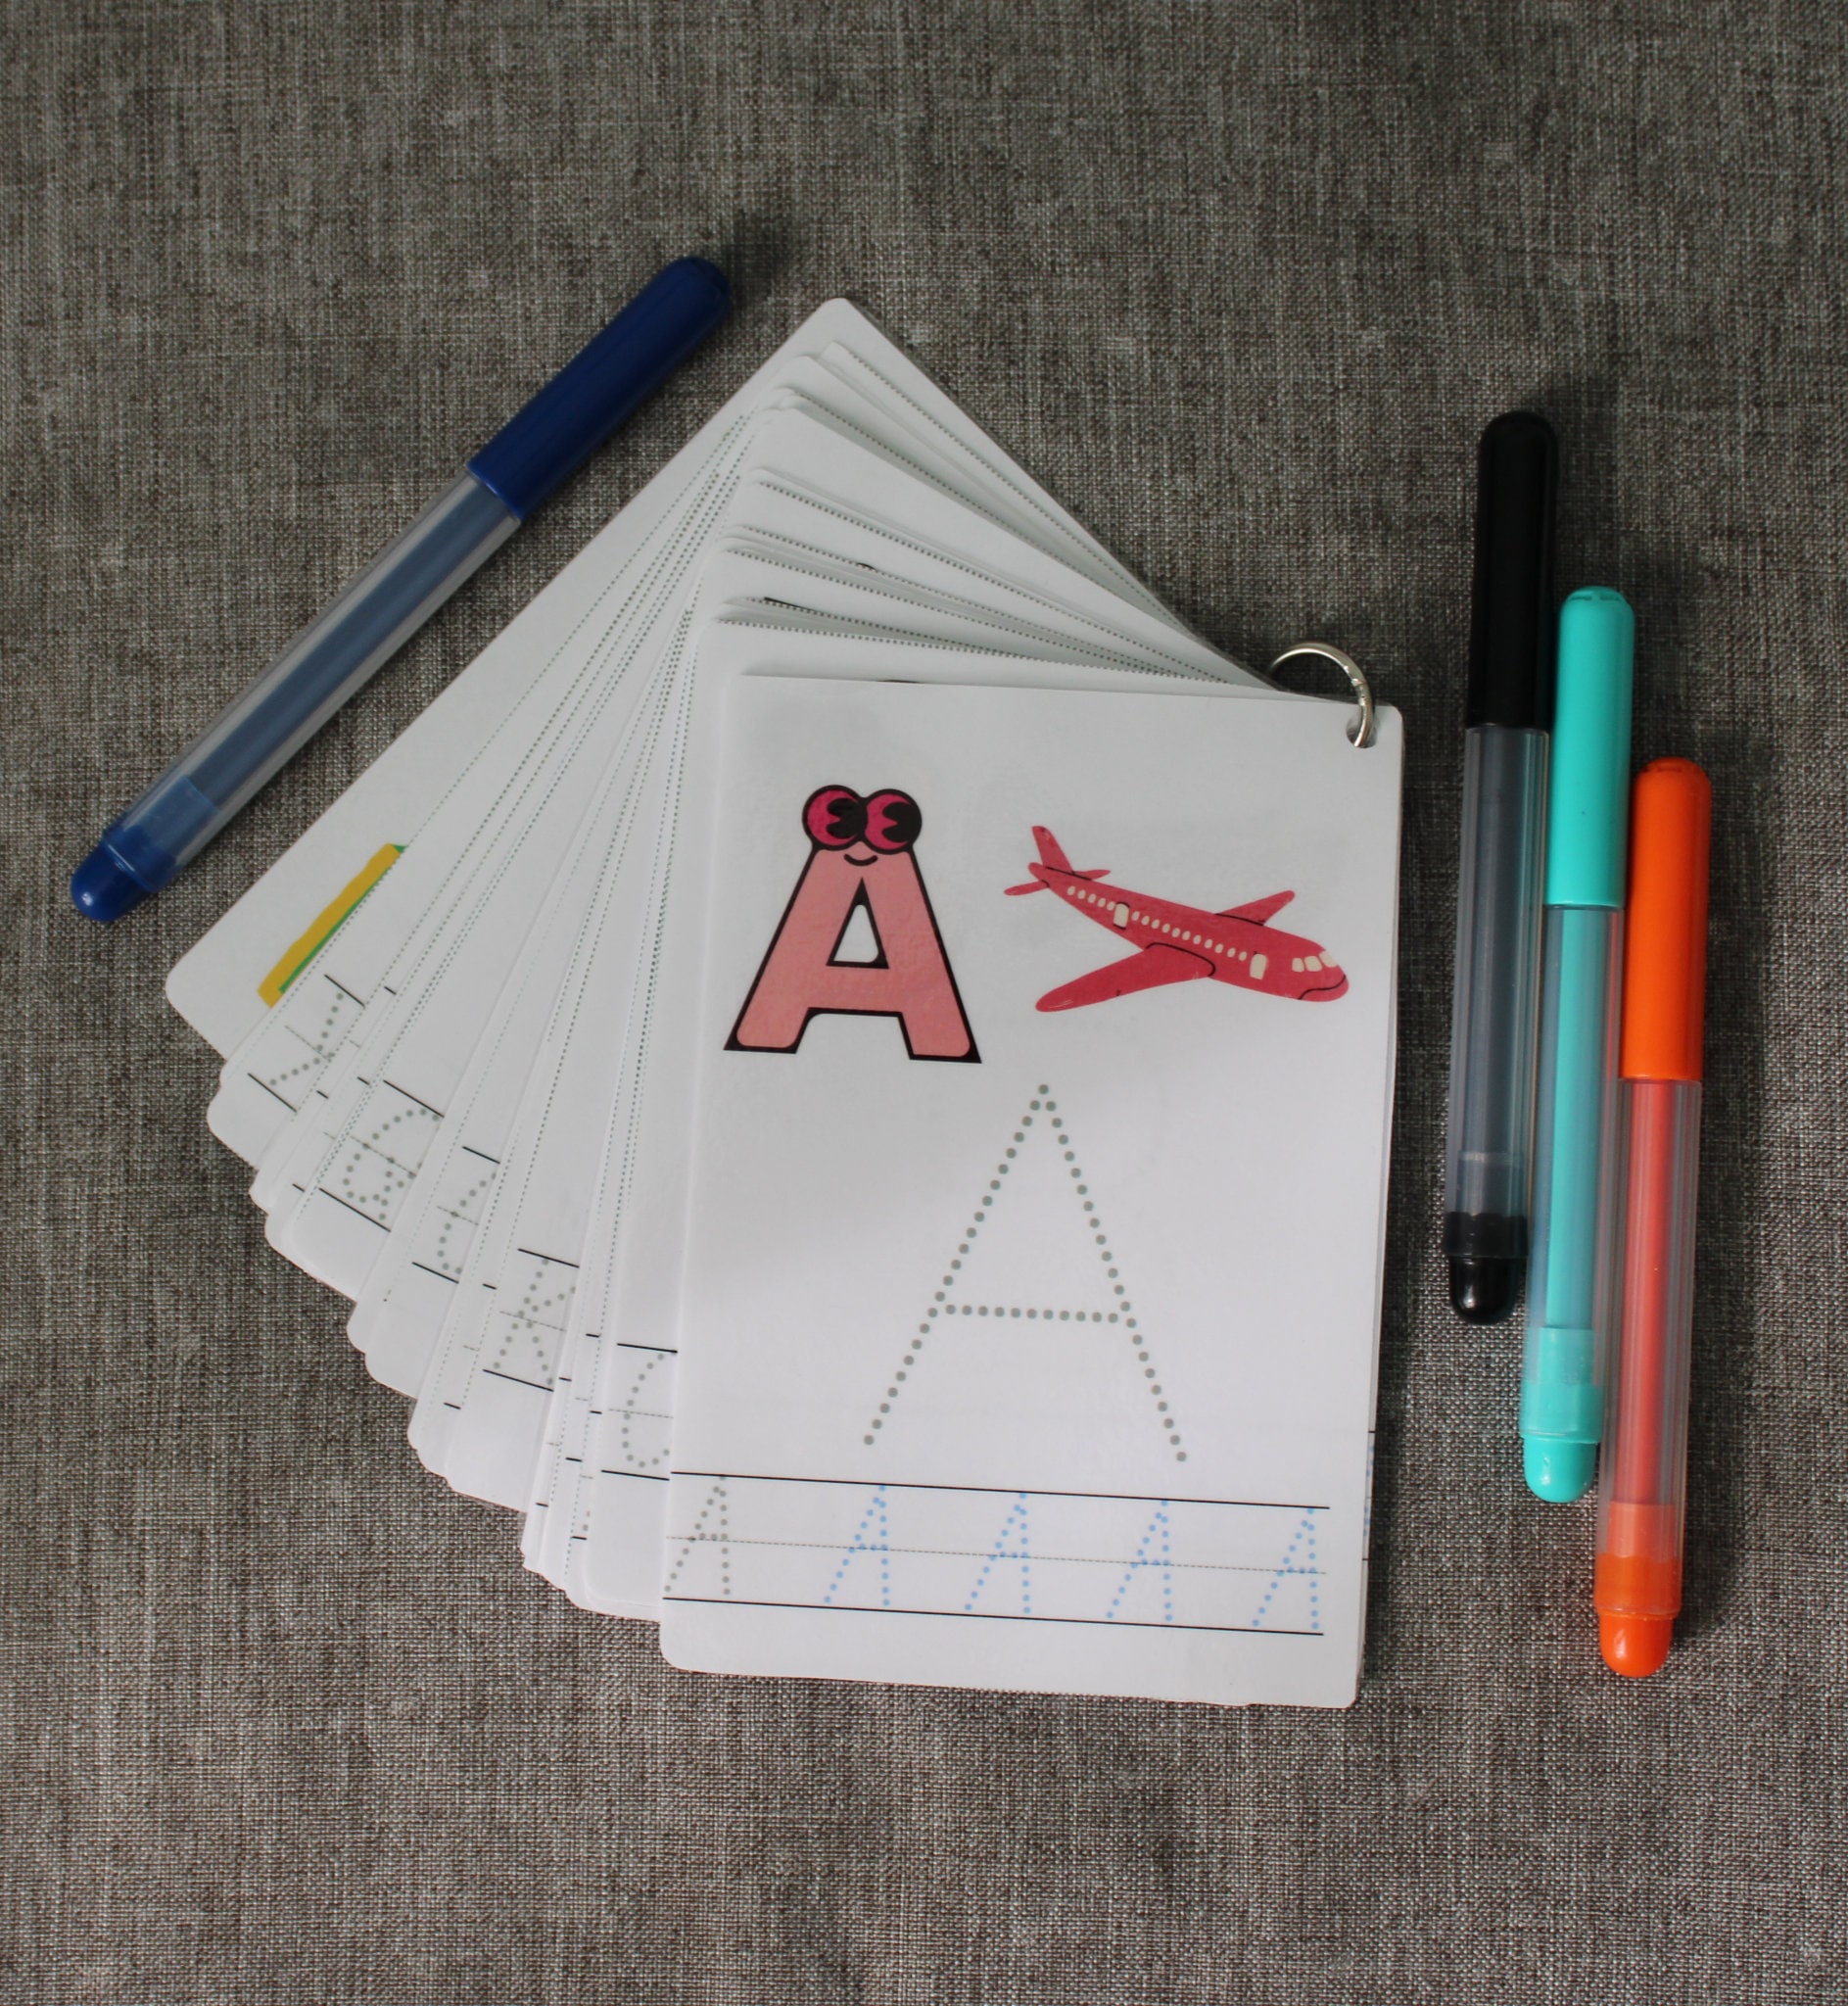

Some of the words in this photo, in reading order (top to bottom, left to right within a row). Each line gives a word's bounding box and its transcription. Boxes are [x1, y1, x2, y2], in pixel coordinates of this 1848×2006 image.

[724, 785, 982, 1064] A
[863, 1083, 1188, 1462] A
[664, 1473, 731, 1596] A
[824, 1483, 890, 1606] A
[964, 1491, 1030, 1614] A
[1106, 1499, 1172, 1621] A
[1252, 1506, 1319, 1630] A
